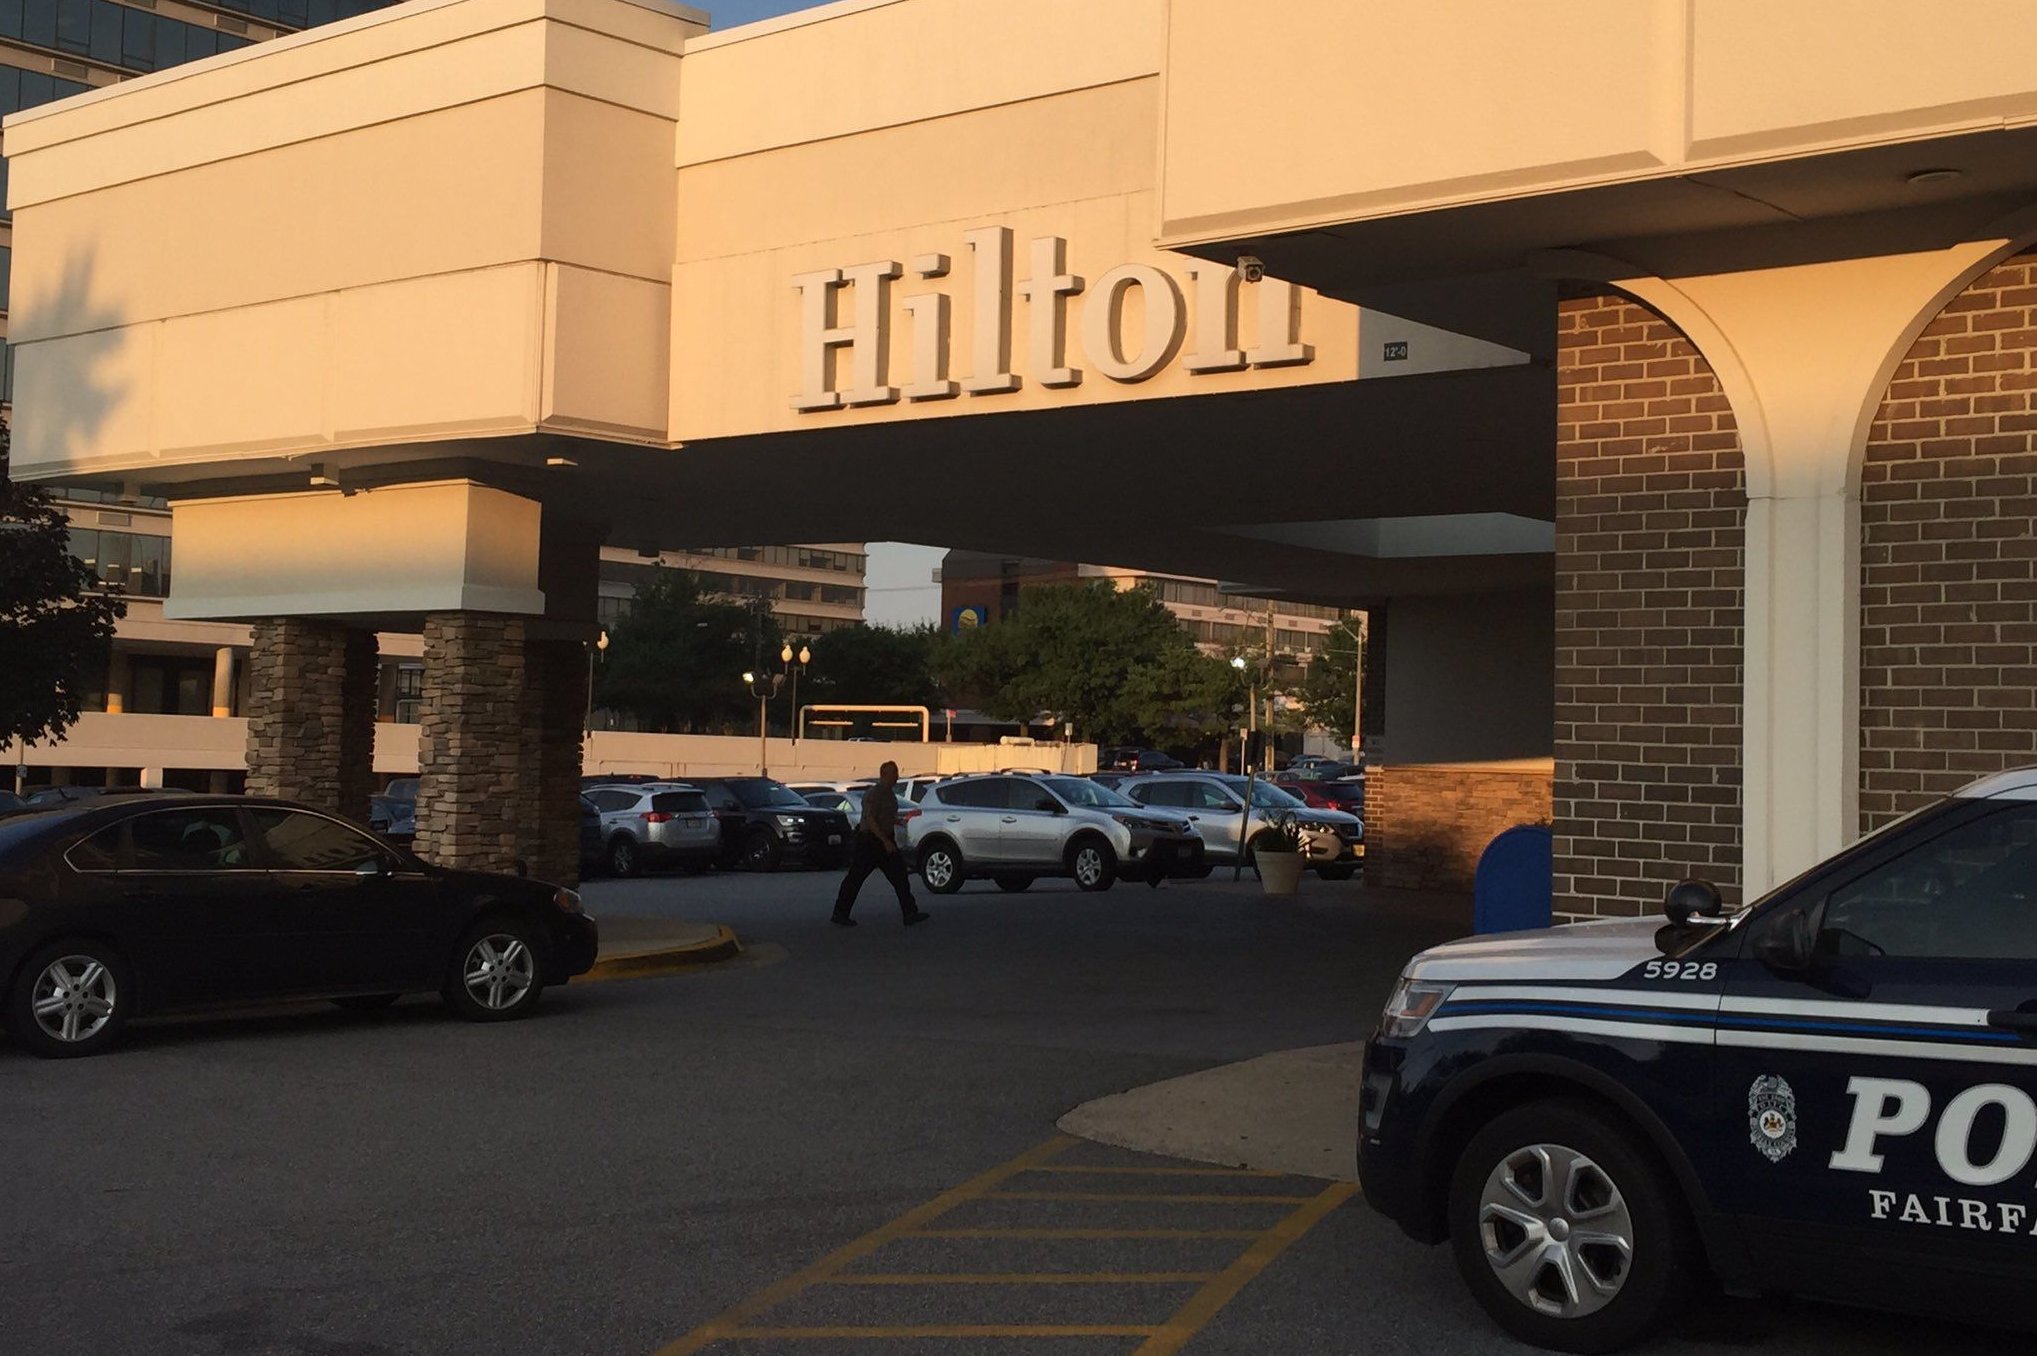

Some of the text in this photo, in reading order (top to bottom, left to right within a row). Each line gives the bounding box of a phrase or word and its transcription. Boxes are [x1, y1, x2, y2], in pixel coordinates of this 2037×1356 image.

[791, 226, 1315, 413] Hilton
[1643, 961, 1718, 980] 5928
[1828, 1076, 2037, 1187] PO
